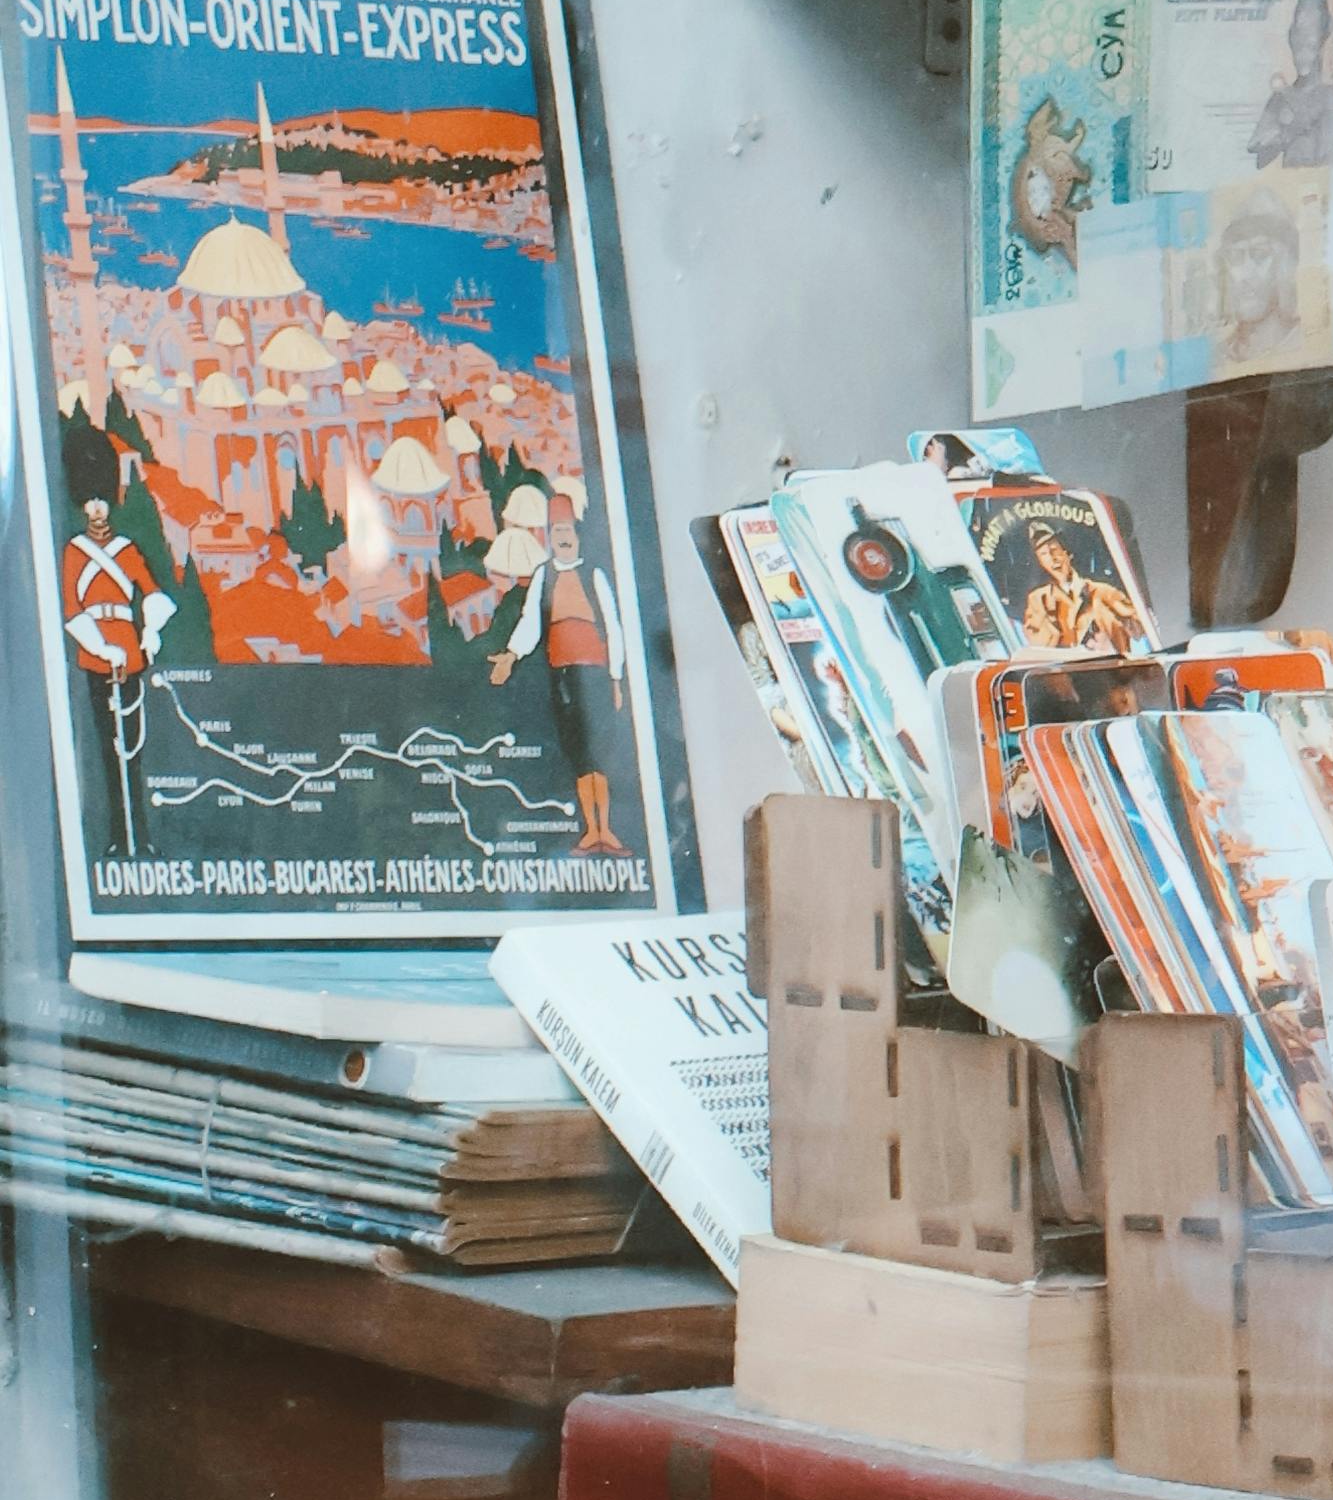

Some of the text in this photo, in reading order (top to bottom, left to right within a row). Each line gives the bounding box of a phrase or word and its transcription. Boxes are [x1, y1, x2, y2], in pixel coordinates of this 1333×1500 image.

[1012, 500, 1097, 528] GLORIOUS
[163, 669, 212, 682] LONDRES
[199, 720, 231, 733] PARIS
[534, 998, 585, 1068] KURŞUN
[580, 1056, 622, 1115] KALEM
